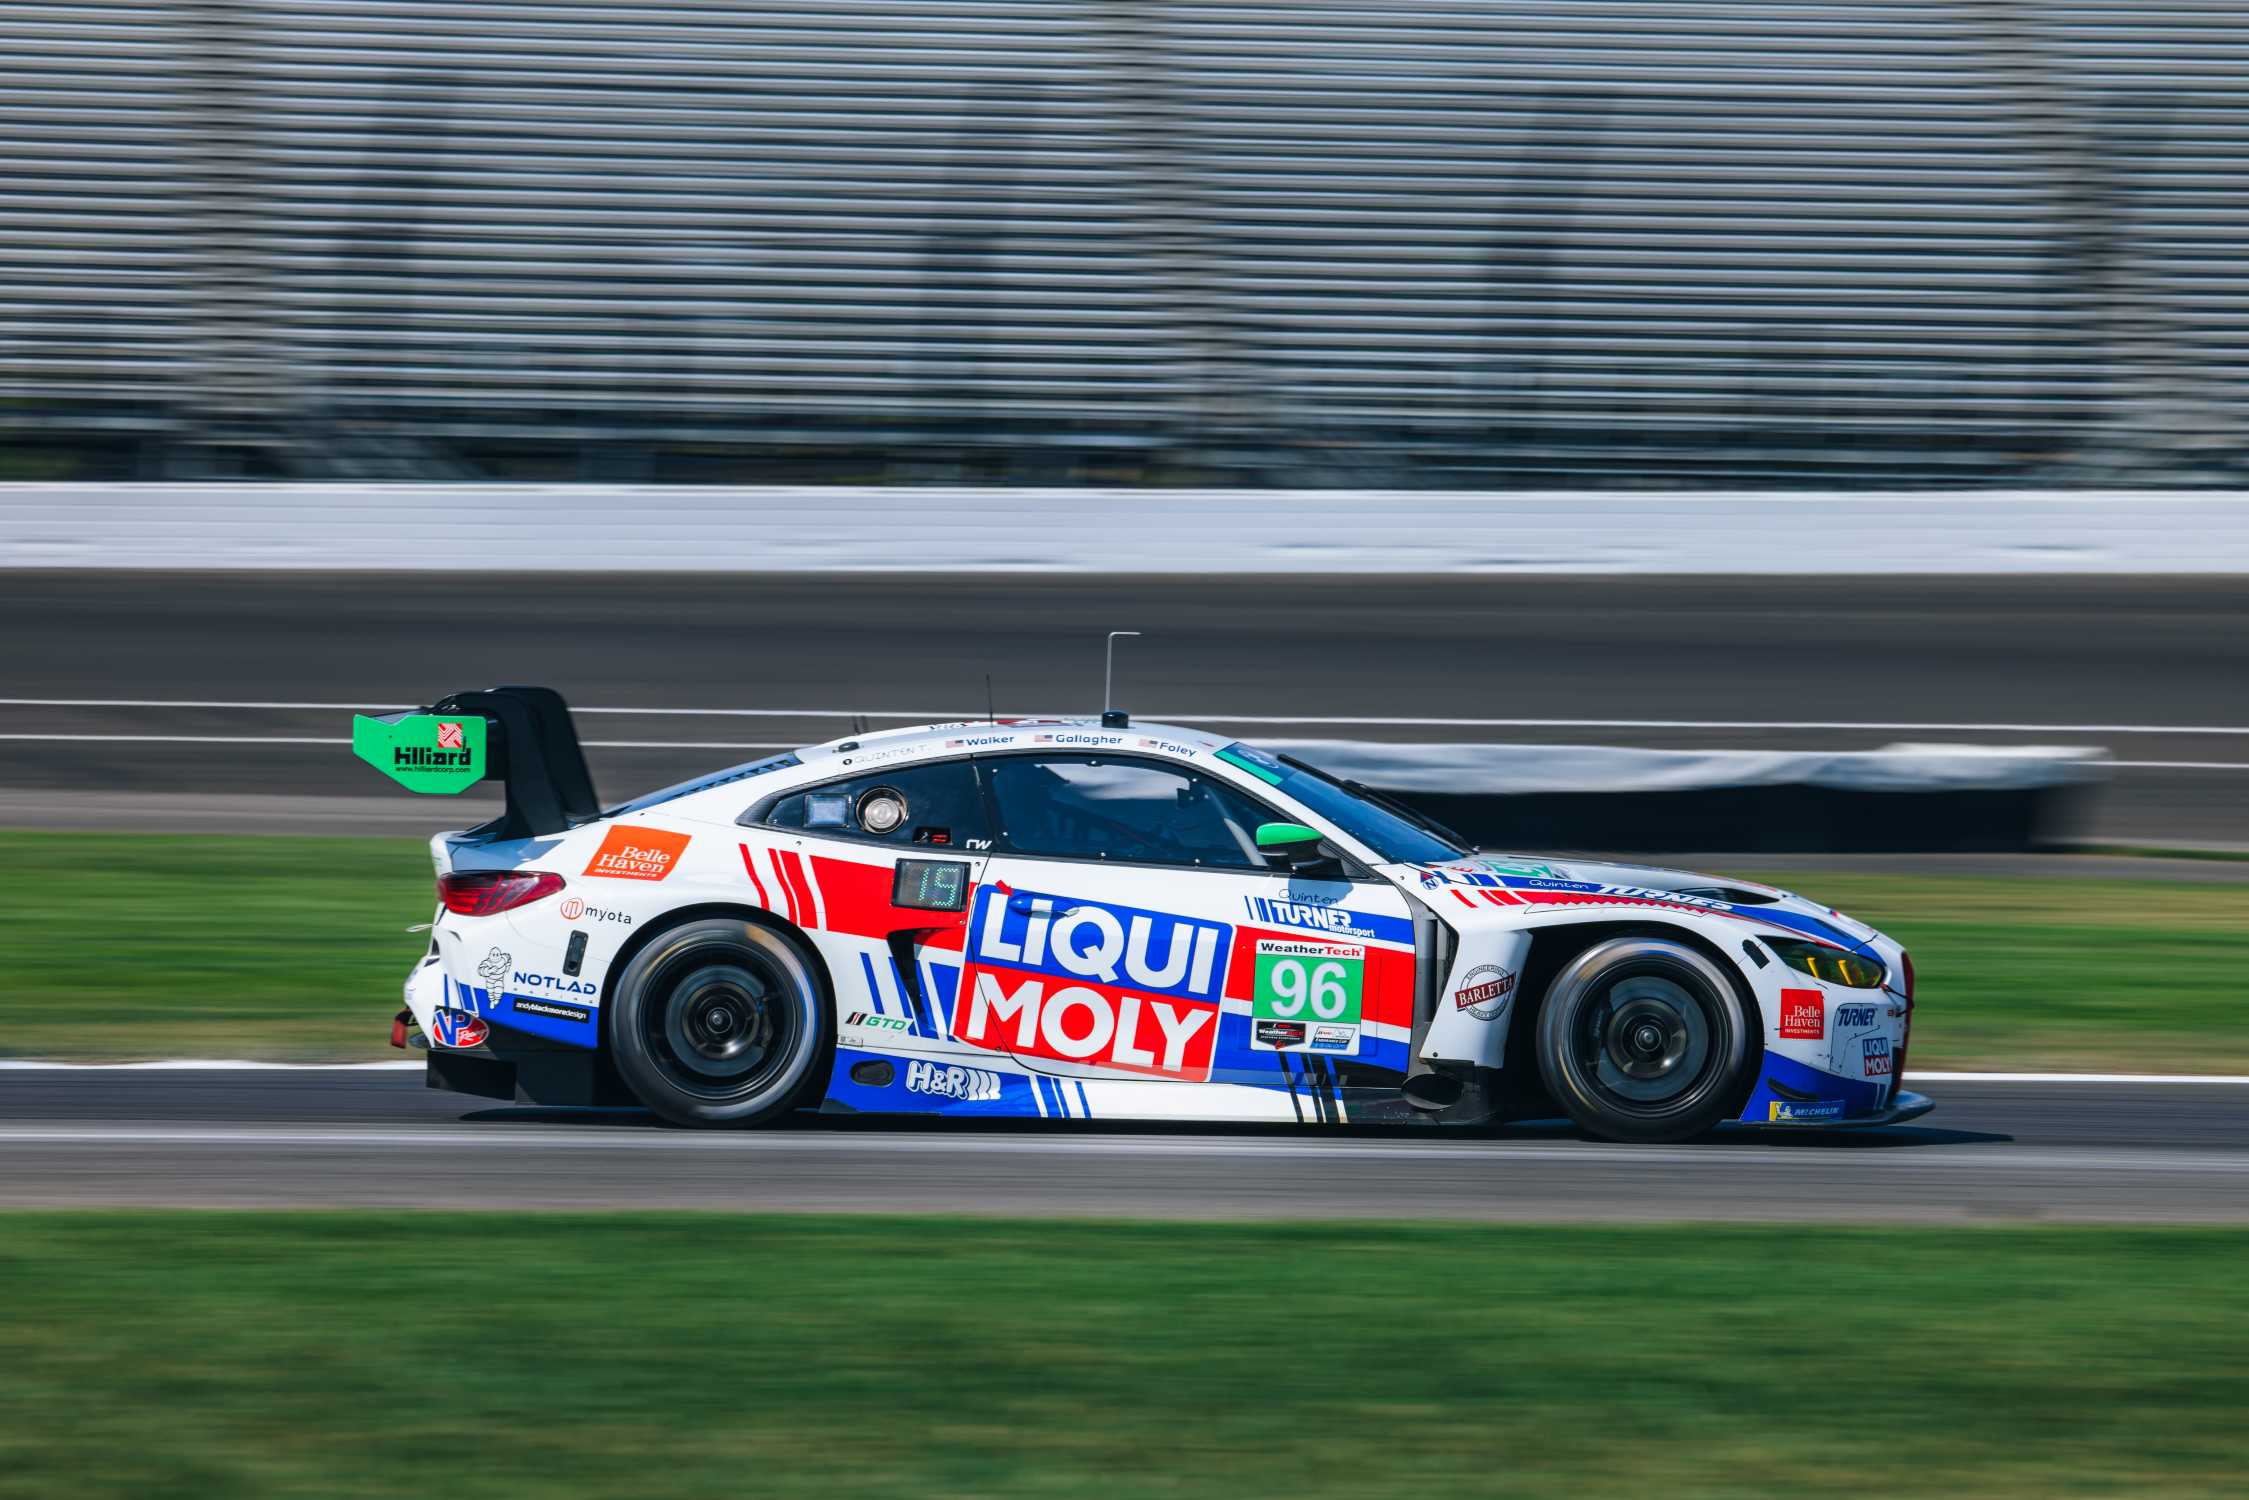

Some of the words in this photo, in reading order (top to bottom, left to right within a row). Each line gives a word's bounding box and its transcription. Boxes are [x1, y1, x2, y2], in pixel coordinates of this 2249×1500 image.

[966, 736, 1014, 746] Walker
[1055, 734, 1122, 744] Gallagher
[394, 742, 471, 765] Hilliard
[1159, 742, 1197, 757] Foley
[597, 854, 664, 872] Haven
[621, 846, 670, 864] Belle
[919, 867, 960, 906] 15
[1529, 879, 1590, 889] Quinten
[1279, 889, 1339, 904] Quinten
[585, 906, 632, 925] myota
[1271, 903, 1351, 929] TURNER
[980, 892, 1219, 995] LIQUI
[1261, 942, 1361, 957] WeatherTech
[513, 971, 596, 994] NOTLAD
[1270, 959, 1348, 1019] 96
[1784, 1014, 1821, 1027] Haven
[1794, 1005, 1821, 1018] Belle
[1838, 1008, 1876, 1027] TURNER
[435, 1008, 473, 1046] VP
[865, 1016, 907, 1030] GTD
[966, 971, 1215, 1072] MOLY
[1864, 1040, 1888, 1056] LIQUI
[1865, 1058, 1891, 1074] MOLY
[906, 1060, 971, 1100] H&R
[1794, 1107, 1839, 1115] MICHELIN
